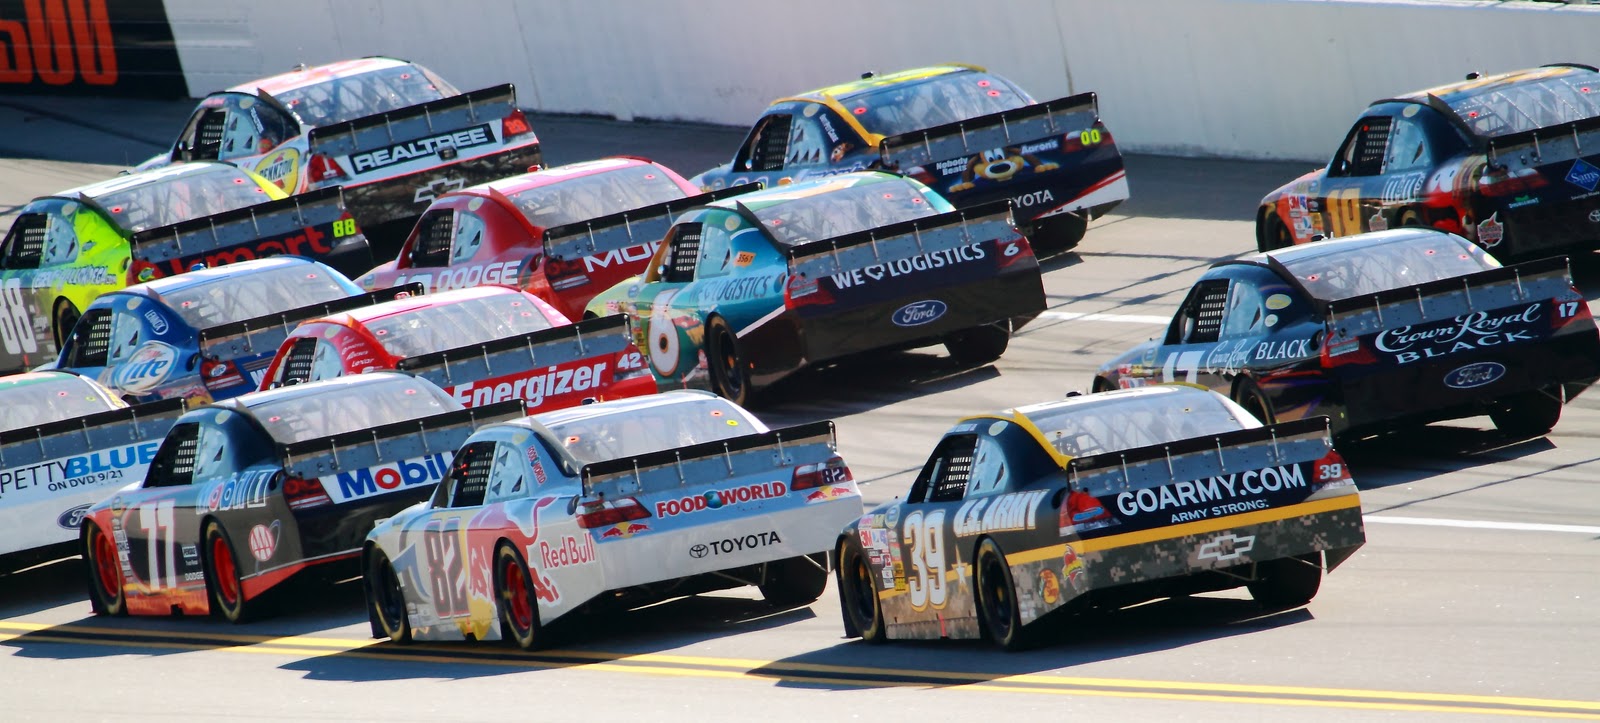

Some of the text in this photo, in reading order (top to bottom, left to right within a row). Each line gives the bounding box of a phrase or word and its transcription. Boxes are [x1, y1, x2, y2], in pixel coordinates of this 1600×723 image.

[1080, 128, 1101, 146] 00
[353, 128, 487, 172] REALTREE
[936, 157, 968, 171] Nobody
[942, 164, 967, 176] Beats
[1010, 189, 1054, 208] YOTA
[333, 218, 356, 238] 88
[1004, 244, 1019, 257] 6
[437, 260, 521, 292] DODGE
[831, 242, 985, 290] WE LOGISTICS
[902, 303, 935, 323] Ford
[1558, 302, 1578, 318] 17
[1375, 303, 1541, 352] Crown Royal
[1255, 339, 1310, 360] BLACK
[1396, 329, 1534, 364] BLACK
[617, 352, 642, 369] 42
[452, 362, 607, 408] Energizer
[1456, 365, 1493, 385] Ford
[47, 470, 124, 492] ON DVD 9/21
[336, 453, 448, 499] Mobil
[821, 467, 846, 485] 82
[1319, 463, 1342, 480] 39
[656, 481, 787, 519] FOOD WORLD
[1116, 463, 1306, 516] GOARMY.COM
[981, 489, 1051, 534] ARMY
[1171, 508, 1207, 524] ARMY
[540, 532, 596, 569] Red Bull
[710, 531, 781, 555] TOYOTA
[424, 516, 471, 619] 82
[903, 509, 947, 612] 39
